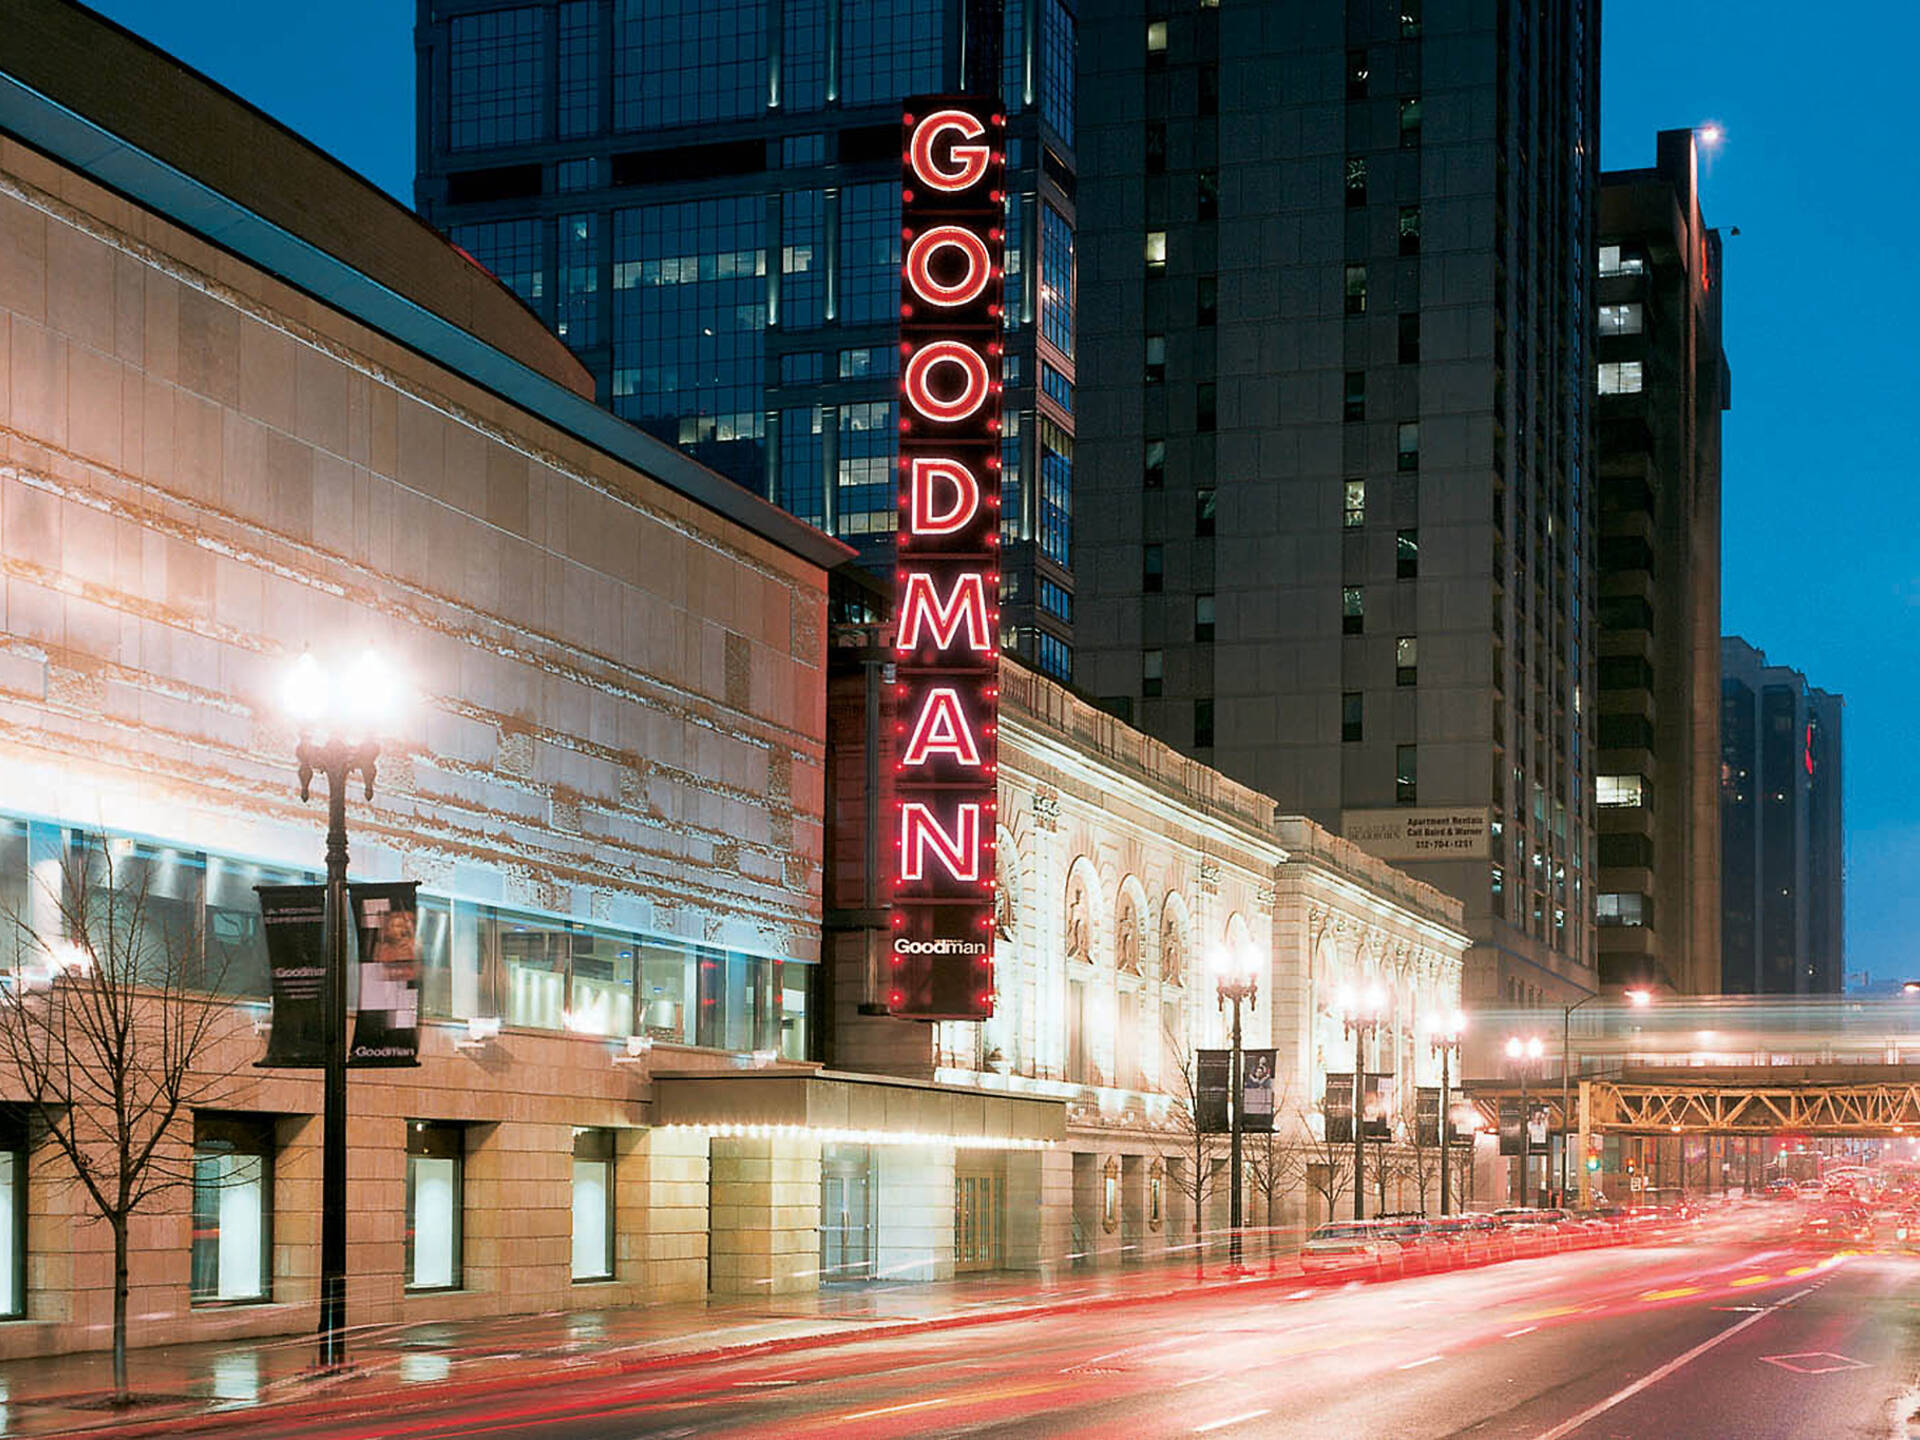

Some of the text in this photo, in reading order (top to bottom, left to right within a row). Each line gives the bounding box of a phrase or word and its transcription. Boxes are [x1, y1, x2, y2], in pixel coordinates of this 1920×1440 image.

[896, 110, 991, 881] GOODMAN
[1407, 817, 1450, 826] Apartment
[1407, 827, 1422, 836] Call
[894, 938, 986, 954] Goodman
[355, 1046, 415, 1057] Goodman
